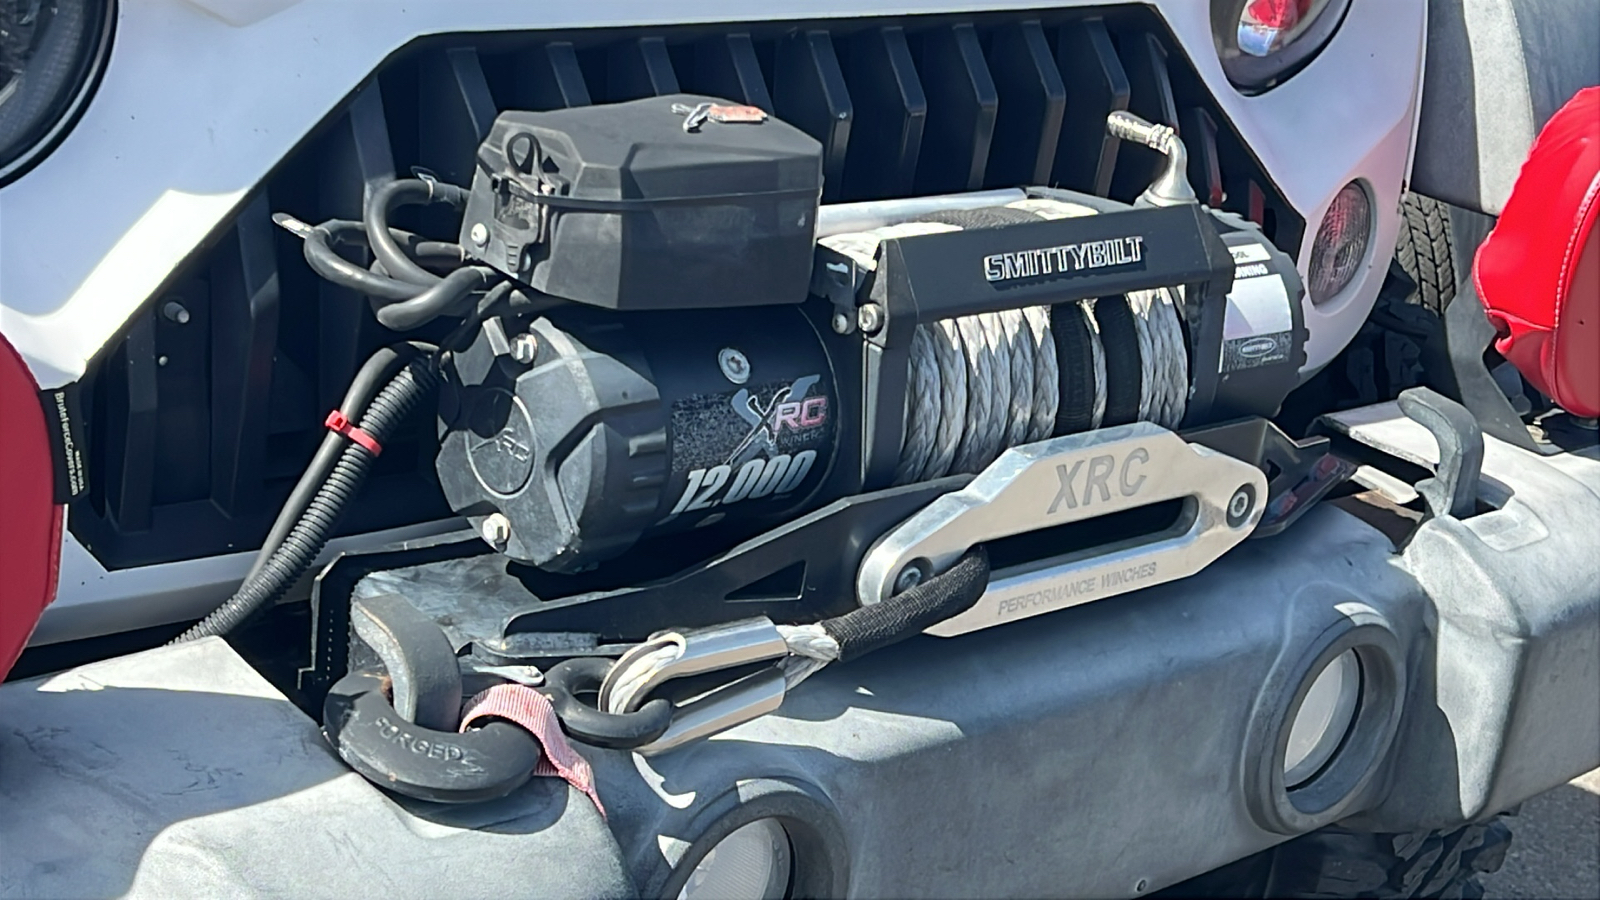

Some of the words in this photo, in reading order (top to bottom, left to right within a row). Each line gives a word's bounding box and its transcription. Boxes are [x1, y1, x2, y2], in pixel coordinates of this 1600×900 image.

[983, 235, 1143, 282] SMITTYBILT
[1046, 447, 1150, 515] XRC
[997, 577, 1097, 616] PERFORMANCE
[1100, 562, 1157, 589] WINCHES
